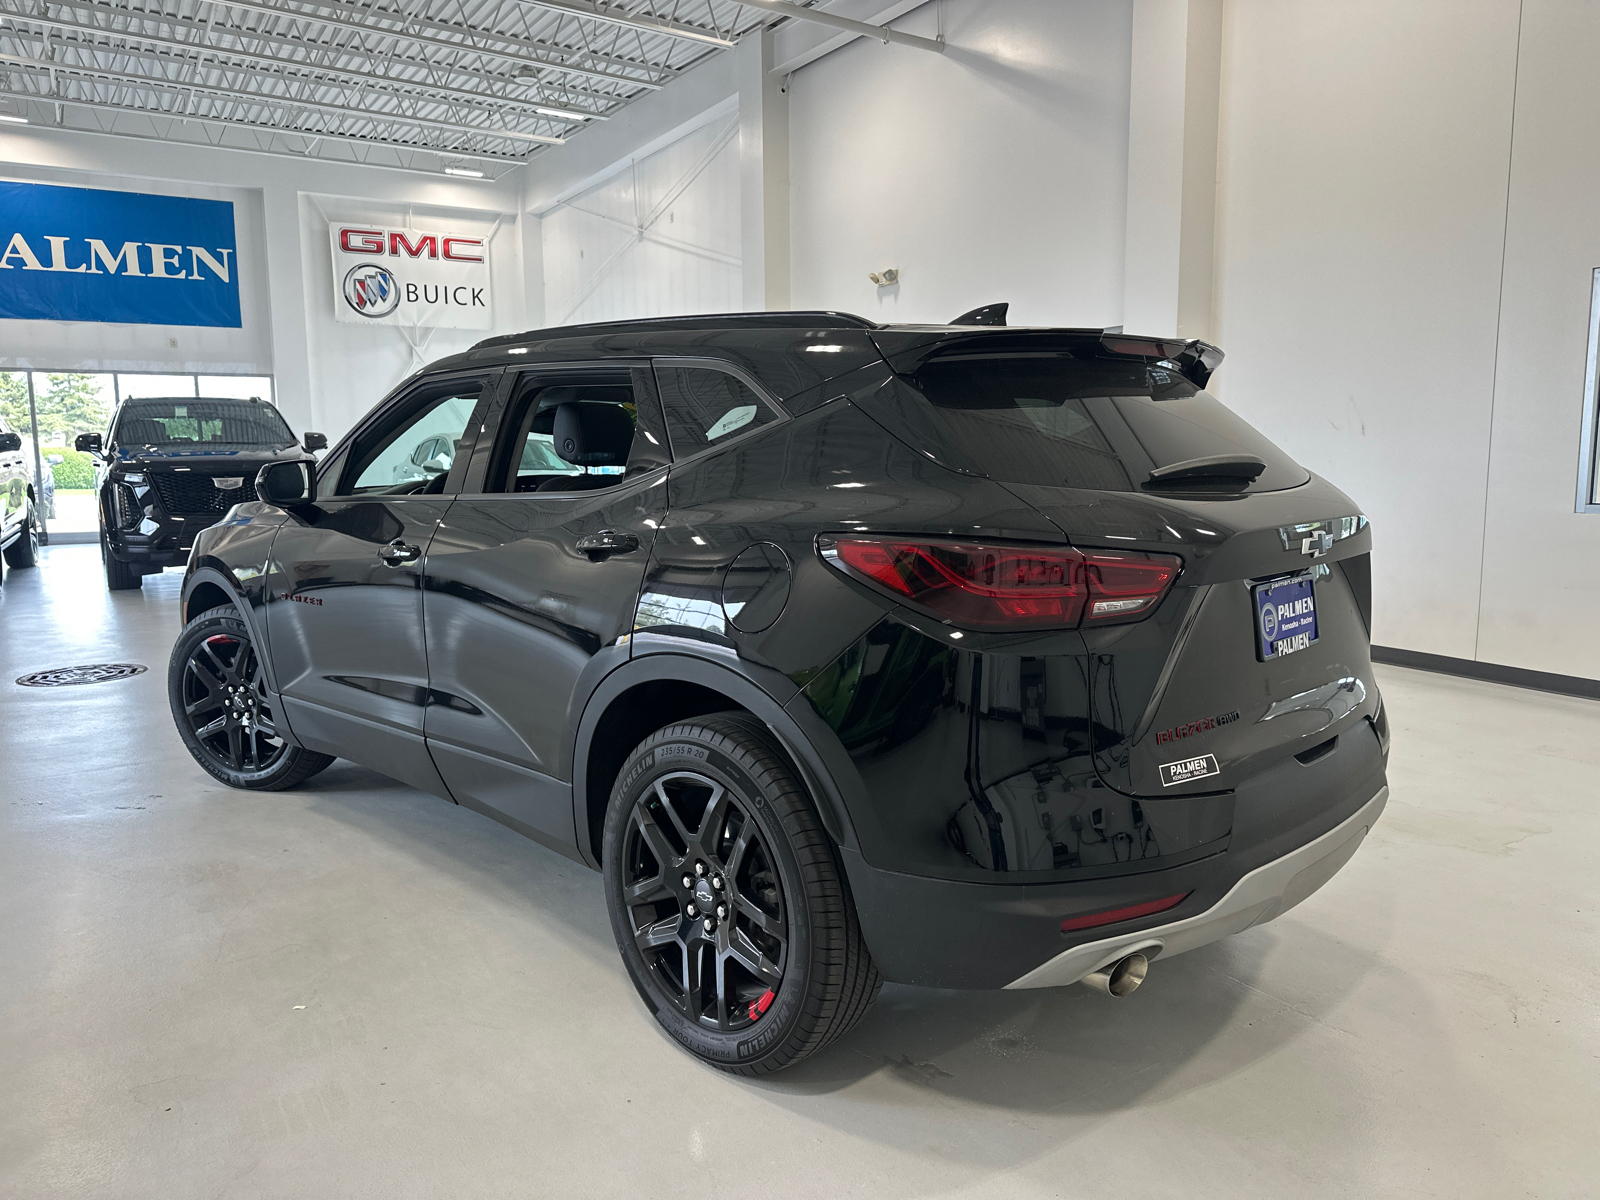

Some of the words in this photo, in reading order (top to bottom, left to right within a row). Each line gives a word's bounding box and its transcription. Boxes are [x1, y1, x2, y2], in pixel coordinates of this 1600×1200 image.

[338, 227, 484, 264] GMC
[406, 283, 485, 307] BUICK
[1271, 577, 1303, 590] palmen.com
[1278, 596, 1314, 620] PALMEN
[1282, 620, 1299, 631] Kenosha
[1301, 616, 1313, 625] Racine
[1278, 632, 1310, 657] PALMEN
[1156, 716, 1216, 745] BLAZER
[192, 746, 230, 780] MICHELIN
[660, 746, 685, 757] 235/55
[686, 747, 693, 756] R
[693, 749, 705, 759] 20
[1170, 758, 1207, 775] PALMEN
[1172, 772, 1192, 781] KENOSHA
[615, 753, 654, 809] MICHELIN
[672, 1027, 693, 1047] TOUR
[738, 1005, 790, 1057] MICHELIN
[695, 1044, 731, 1059] PRIMACY
